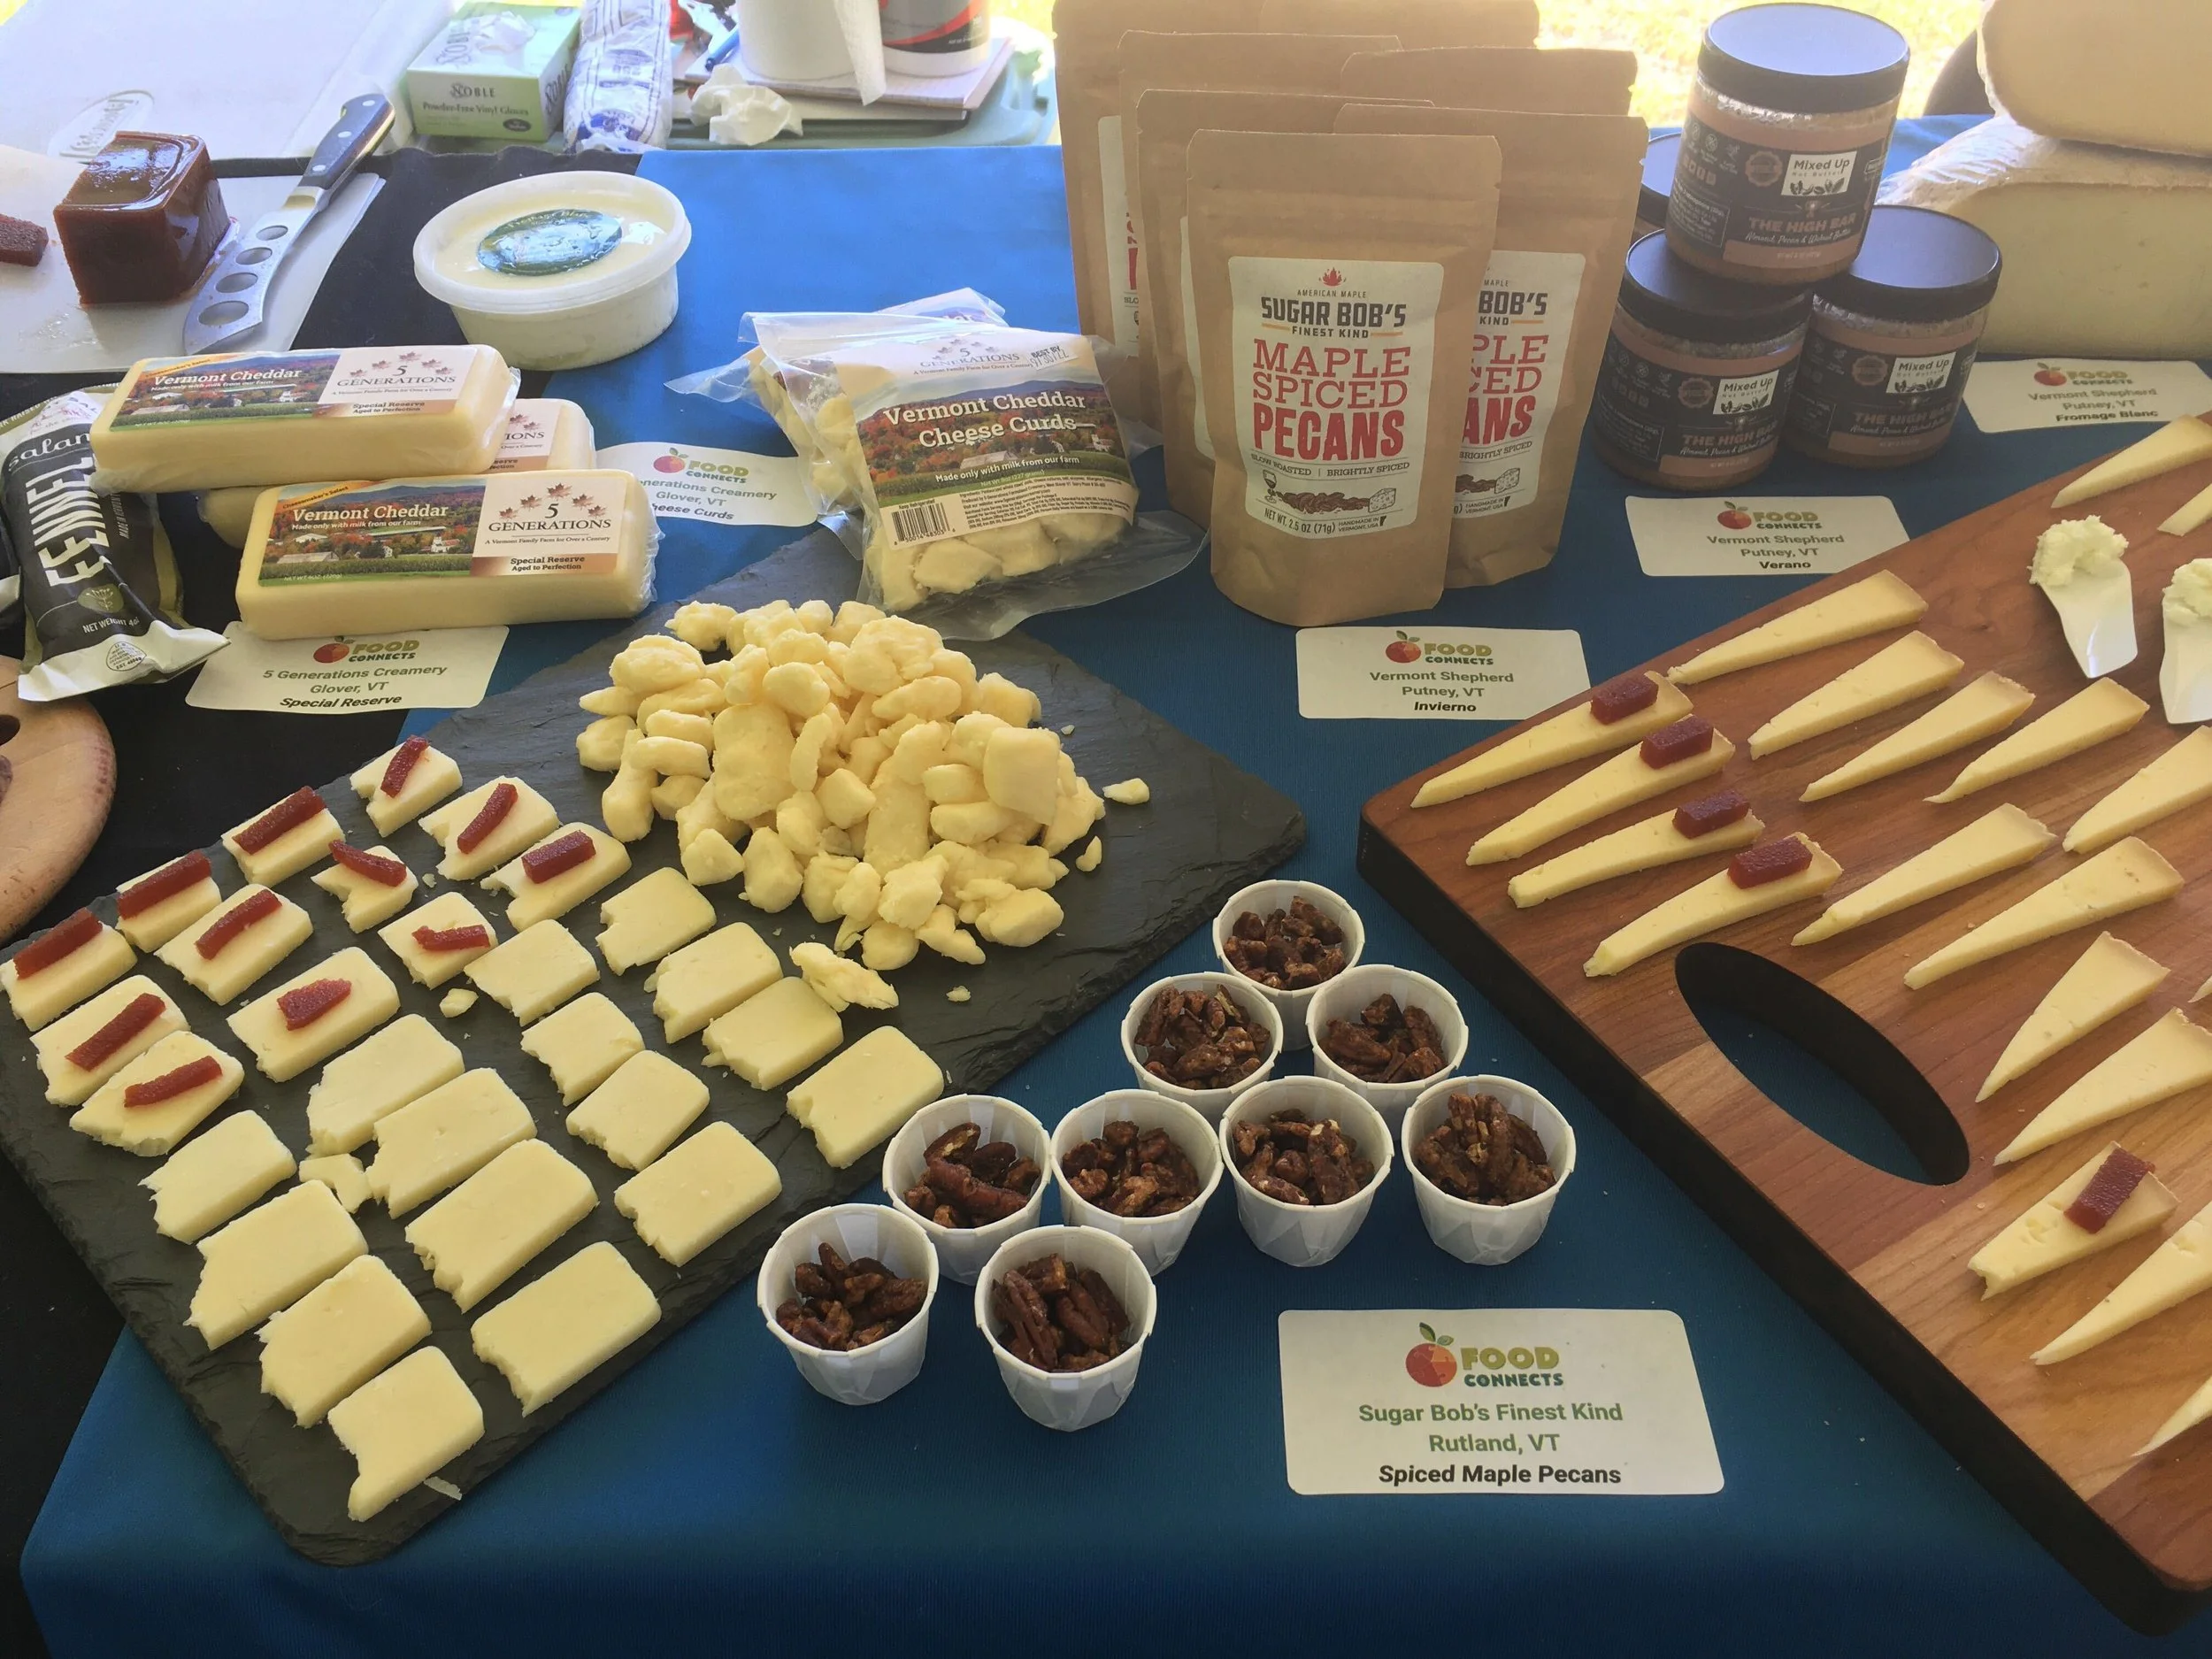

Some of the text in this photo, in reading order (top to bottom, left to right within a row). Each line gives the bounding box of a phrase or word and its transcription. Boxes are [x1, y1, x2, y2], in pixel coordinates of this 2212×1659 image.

[449, 81, 495, 99] NOBLE
[423, 102, 529, 116] Powder-Free Vinyl Gloves
[1794, 159, 1832, 170] Mixed
[1835, 159, 1850, 173] Up
[1749, 212, 1856, 232] THE HIGH BAR
[1484, 279, 1509, 288] MAPLE
[1297, 289, 1367, 299] AMERICAN MAPLE
[1479, 290, 1548, 316] BOB'S
[1261, 296, 1407, 328] SUGAR BOB'S
[1479, 316, 1509, 326] KIND
[1292, 326, 1370, 339] FINEST KIND
[960, 347, 971, 357] 5
[1031, 348, 1049, 358] BEST
[1253, 338, 1411, 379] MAPLE
[920, 353, 1020, 368] GENERATIONS
[1899, 358, 1950, 373] Mixed Up
[155, 368, 303, 386] Vermont Cheddar
[392, 365, 408, 377] 5
[2066, 370, 2129, 380] FOOD
[337, 376, 457, 387] GENERATIONS
[1724, 378, 1773, 392] Mixed Up
[1253, 371, 1409, 409] SPICED
[2028, 388, 2158, 401] Vermont Shepherd
[883, 390, 1087, 426] Vermont Cheddar
[2063, 401, 2115, 411] Putney,
[2055, 410, 2158, 422] Fromage Blanc
[919, 413, 1078, 448] Cheese Curds
[1253, 402, 1405, 461] PECANS
[1682, 432, 1755, 446] THE HIGH
[1503, 440, 1532, 456] SPICED
[688, 460, 749, 477] FOOD
[935, 473, 959, 483] Made
[961, 469, 979, 480] only
[980, 465, 1001, 475] with
[1002, 460, 1021, 472] milk
[1022, 458, 1043, 468] from
[1060, 456, 1080, 465] farm
[1250, 453, 1312, 476] SLOW ROASTED
[1327, 462, 1410, 477] BRIGHTLY SPICED
[686, 470, 747, 484] CONNECTS
[639, 479, 777, 500] enerations Creamery
[282, 486, 349, 510] Cheesemaker's Select
[656, 490, 727, 507] Glover, VT
[293, 503, 449, 522] Vermont Cheddar
[544, 503, 559, 518] 5
[694, 507, 734, 520] Curds
[1753, 511, 1818, 523] FOOD
[488, 519, 611, 532] GENERATIONS
[1264, 507, 1336, 535] NET WT. 2.5 OZ (71g)
[1339, 517, 1372, 527] HANDMADE
[1707, 534, 1845, 545] Vermont Shepherd
[1740, 547, 1820, 559] Putney, VT
[511, 557, 545, 565] Special
[1759, 560, 1811, 570] Verano
[82, 618, 127, 634] NET WEIGHT
[352, 639, 419, 655] FOOD
[1424, 642, 1492, 657] FOOD
[348, 652, 416, 663] CONNECTS
[1425, 656, 1494, 665] CONNECTS
[263, 665, 448, 680] 5 Generations Creamery
[1370, 671, 1514, 684] Vermont Shepherd
[310, 681, 389, 695] Glover, VT
[1402, 687, 1486, 699] Putney, VT
[280, 695, 403, 709] Special Reserve
[1414, 701, 1477, 713] Invierno
[1460, 1347, 1561, 1371] FOOD
[1463, 1372, 1564, 1388] CONNECTS
[1358, 1402, 1624, 1425] Sugar Bob's Finest Kind
[1429, 1433, 1561, 1455] Rutland, VT
[1379, 1464, 1622, 1487] Spiced Maple Pecans
